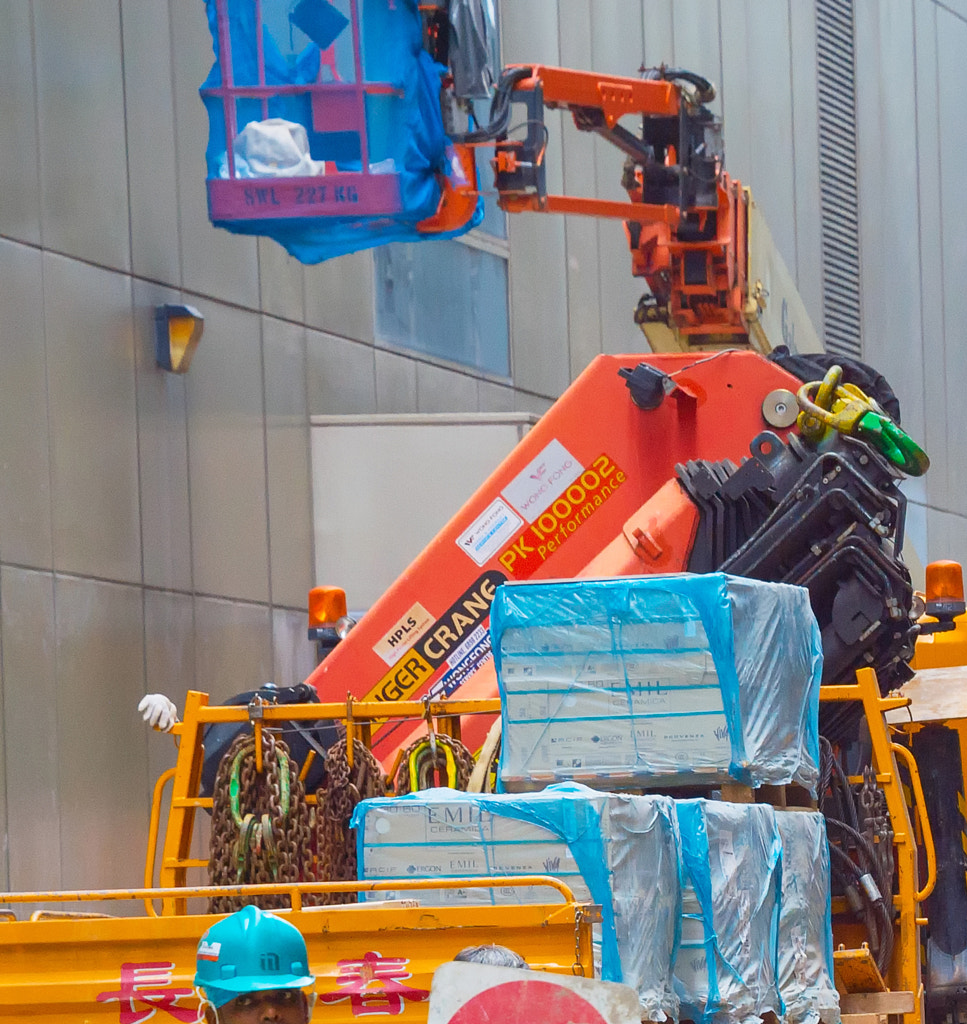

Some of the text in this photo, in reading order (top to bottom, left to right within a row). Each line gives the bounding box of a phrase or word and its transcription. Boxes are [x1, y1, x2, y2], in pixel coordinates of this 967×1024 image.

[244, 187, 280, 206] SWL
[334, 186, 359, 204] KG
[520, 459, 574, 512] WONG FONG
[498, 535, 535, 573] PK
[530, 455, 616, 541] 100002
[537, 470, 627, 561] Performance
[387, 616, 418, 648] HPLS
[423, 578, 497, 660] CRANE
[428, 806, 492, 824] EMIL
[416, 865, 442, 873] ERGON
[450, 859, 479, 870] EMIL
